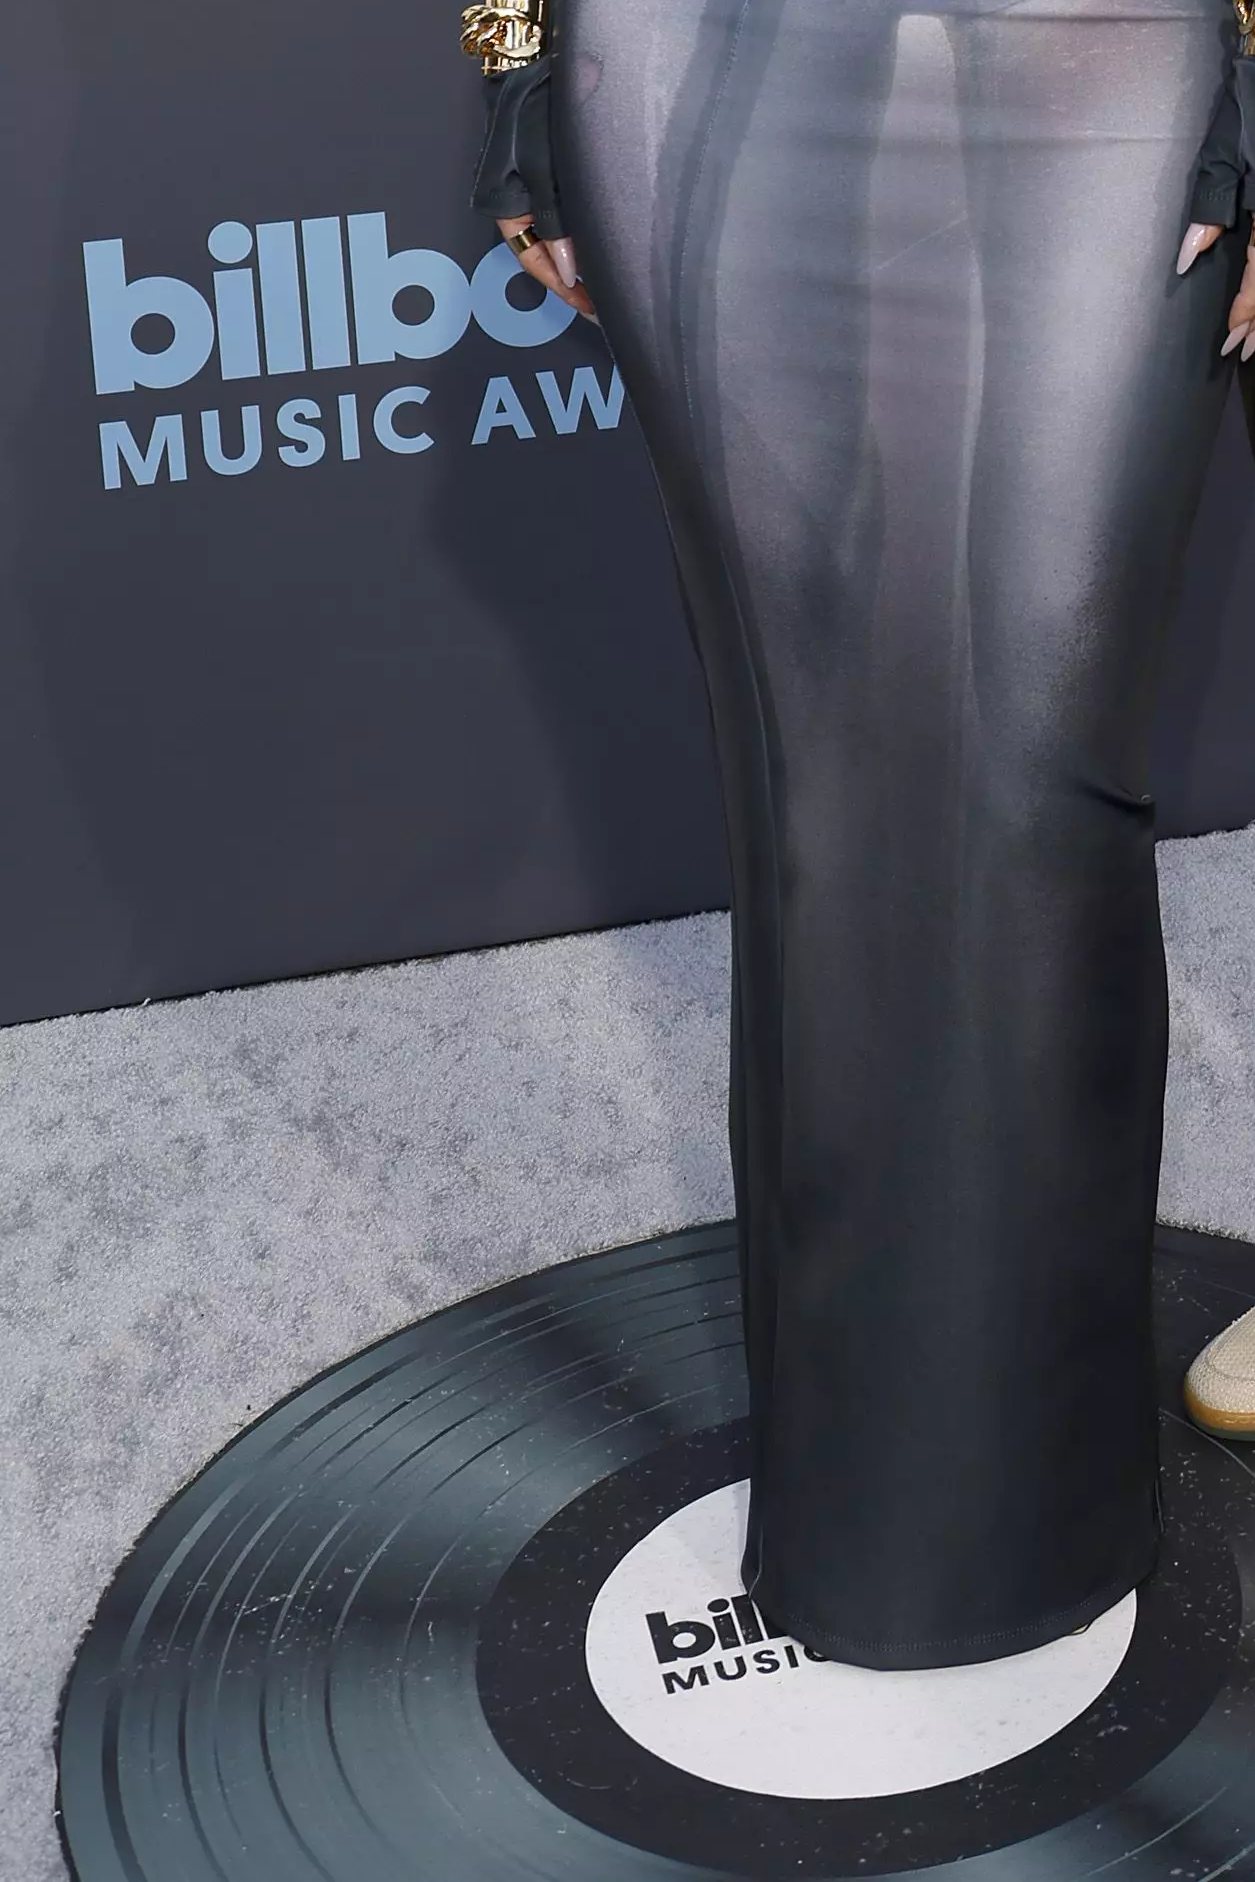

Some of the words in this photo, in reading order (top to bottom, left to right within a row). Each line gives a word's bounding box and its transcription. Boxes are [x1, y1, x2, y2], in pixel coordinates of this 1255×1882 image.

[83, 211, 578, 395] billbo
[99, 385, 434, 490] MUSIC
[471, 366, 625, 445] AW
